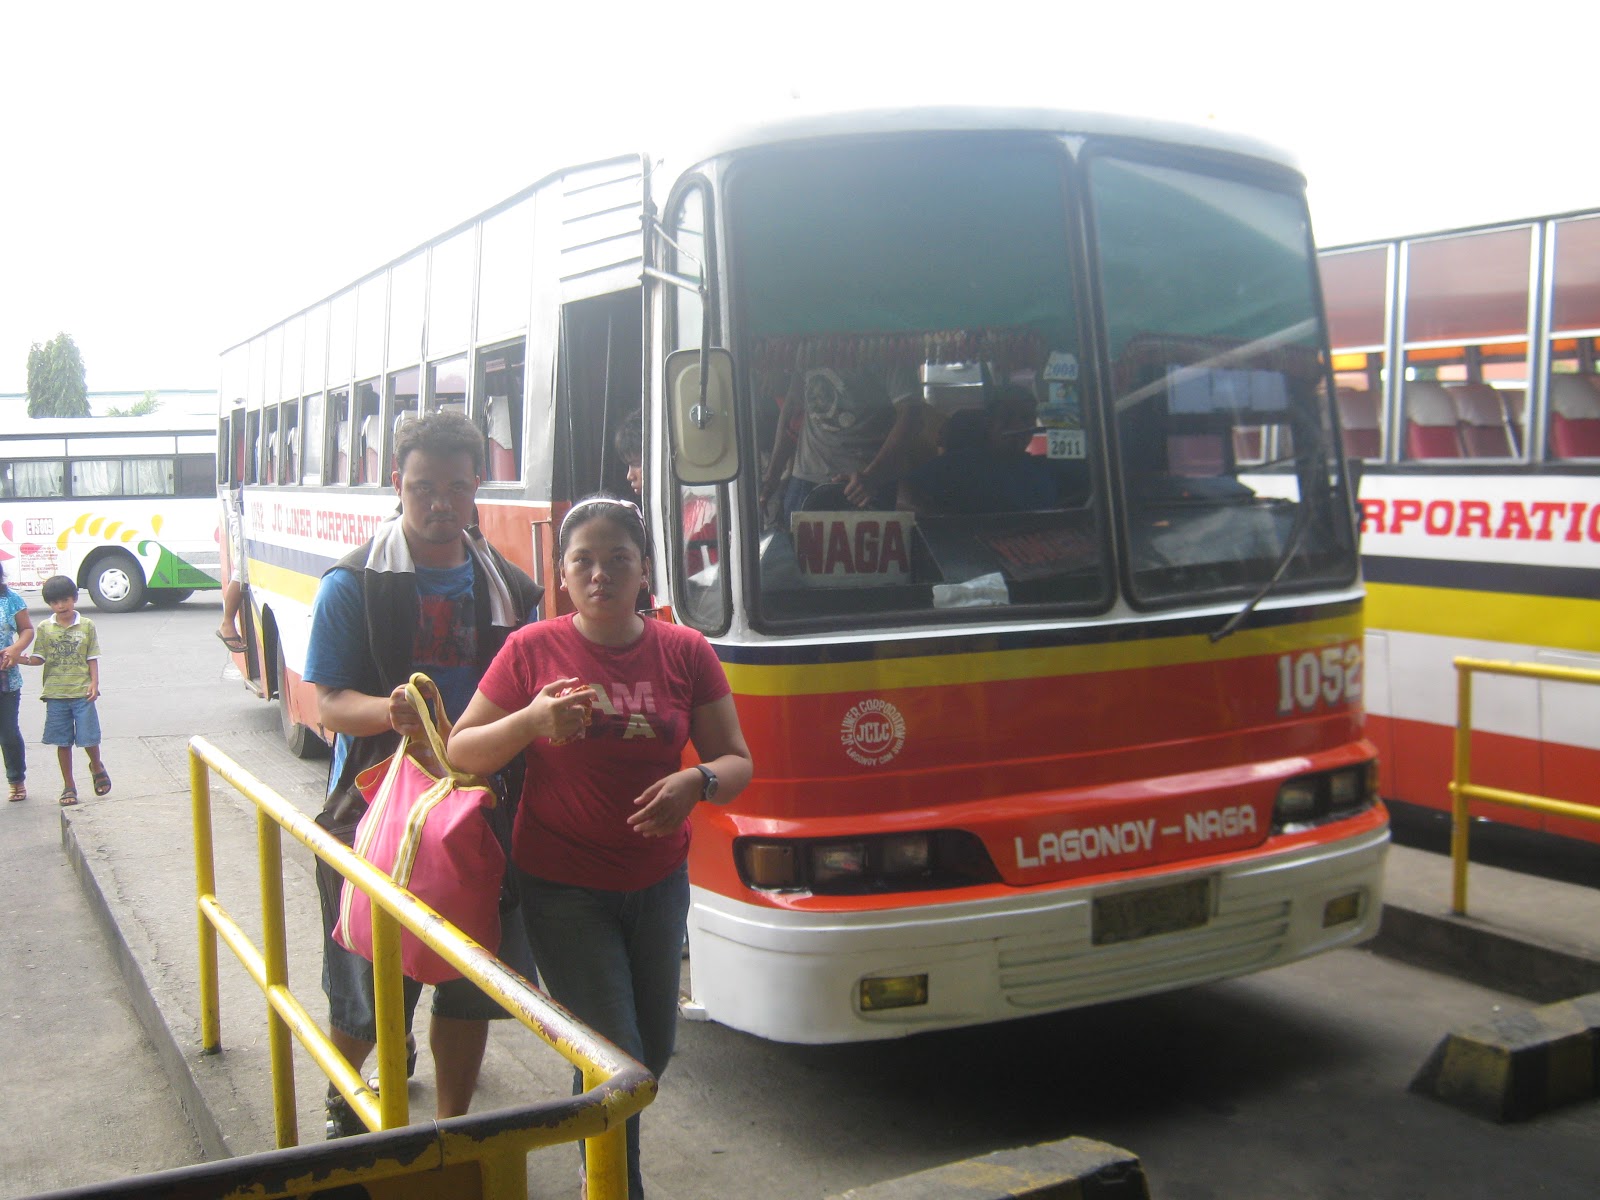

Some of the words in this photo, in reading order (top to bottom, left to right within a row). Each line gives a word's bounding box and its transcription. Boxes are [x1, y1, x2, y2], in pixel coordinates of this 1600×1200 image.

[1051, 440, 1081, 455] 2011
[271, 503, 283, 532] JC
[286, 508, 313, 538] LINER
[797, 520, 909, 575] NAGA
[1278, 644, 1362, 716] 1052
[841, 706, 861, 733] LINER
[859, 699, 906, 739] CORPORATION
[856, 722, 890, 743] JCLC
[1014, 817, 1156, 869] LAGONOY
[1184, 803, 1258, 843] NAGA
